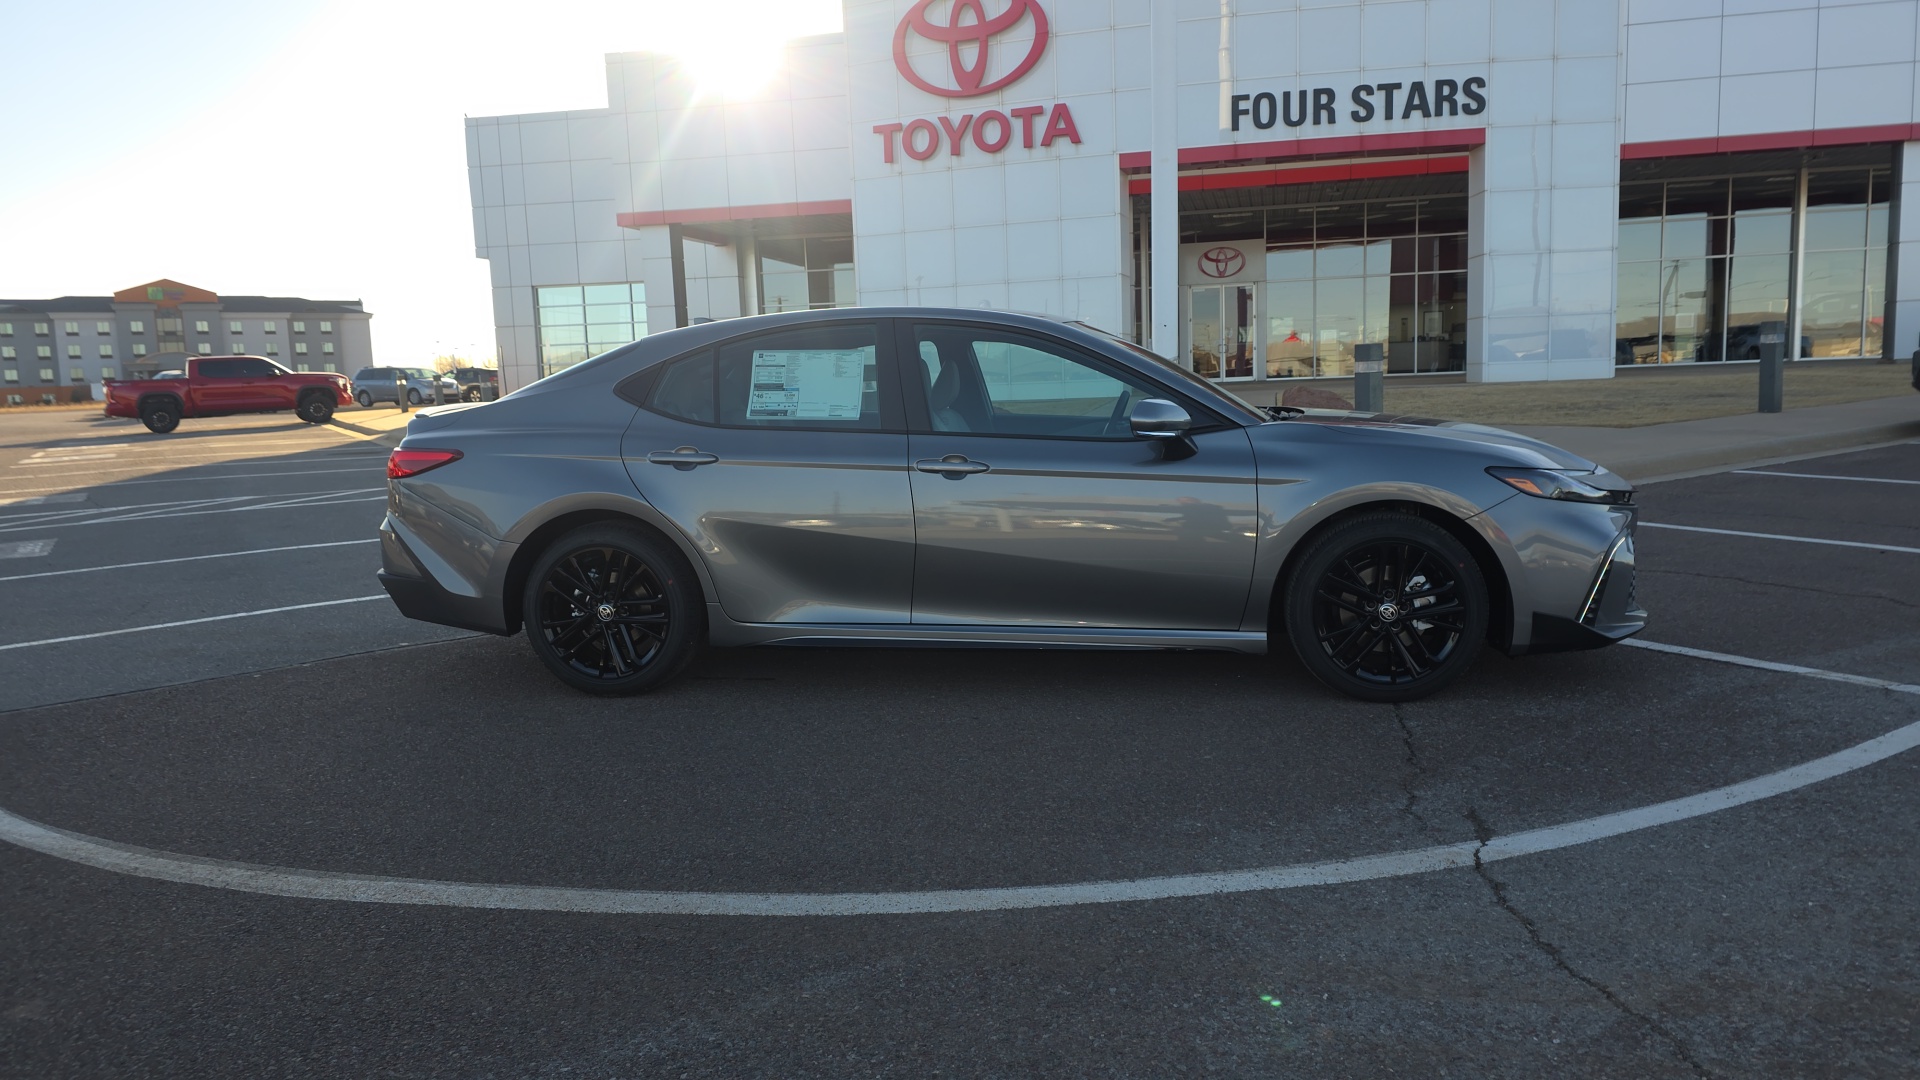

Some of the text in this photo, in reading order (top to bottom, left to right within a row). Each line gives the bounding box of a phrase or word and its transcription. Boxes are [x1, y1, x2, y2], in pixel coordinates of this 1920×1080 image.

[873, 102, 1082, 163] TOYOTA
[1231, 76, 1487, 132] FOUR STARS
